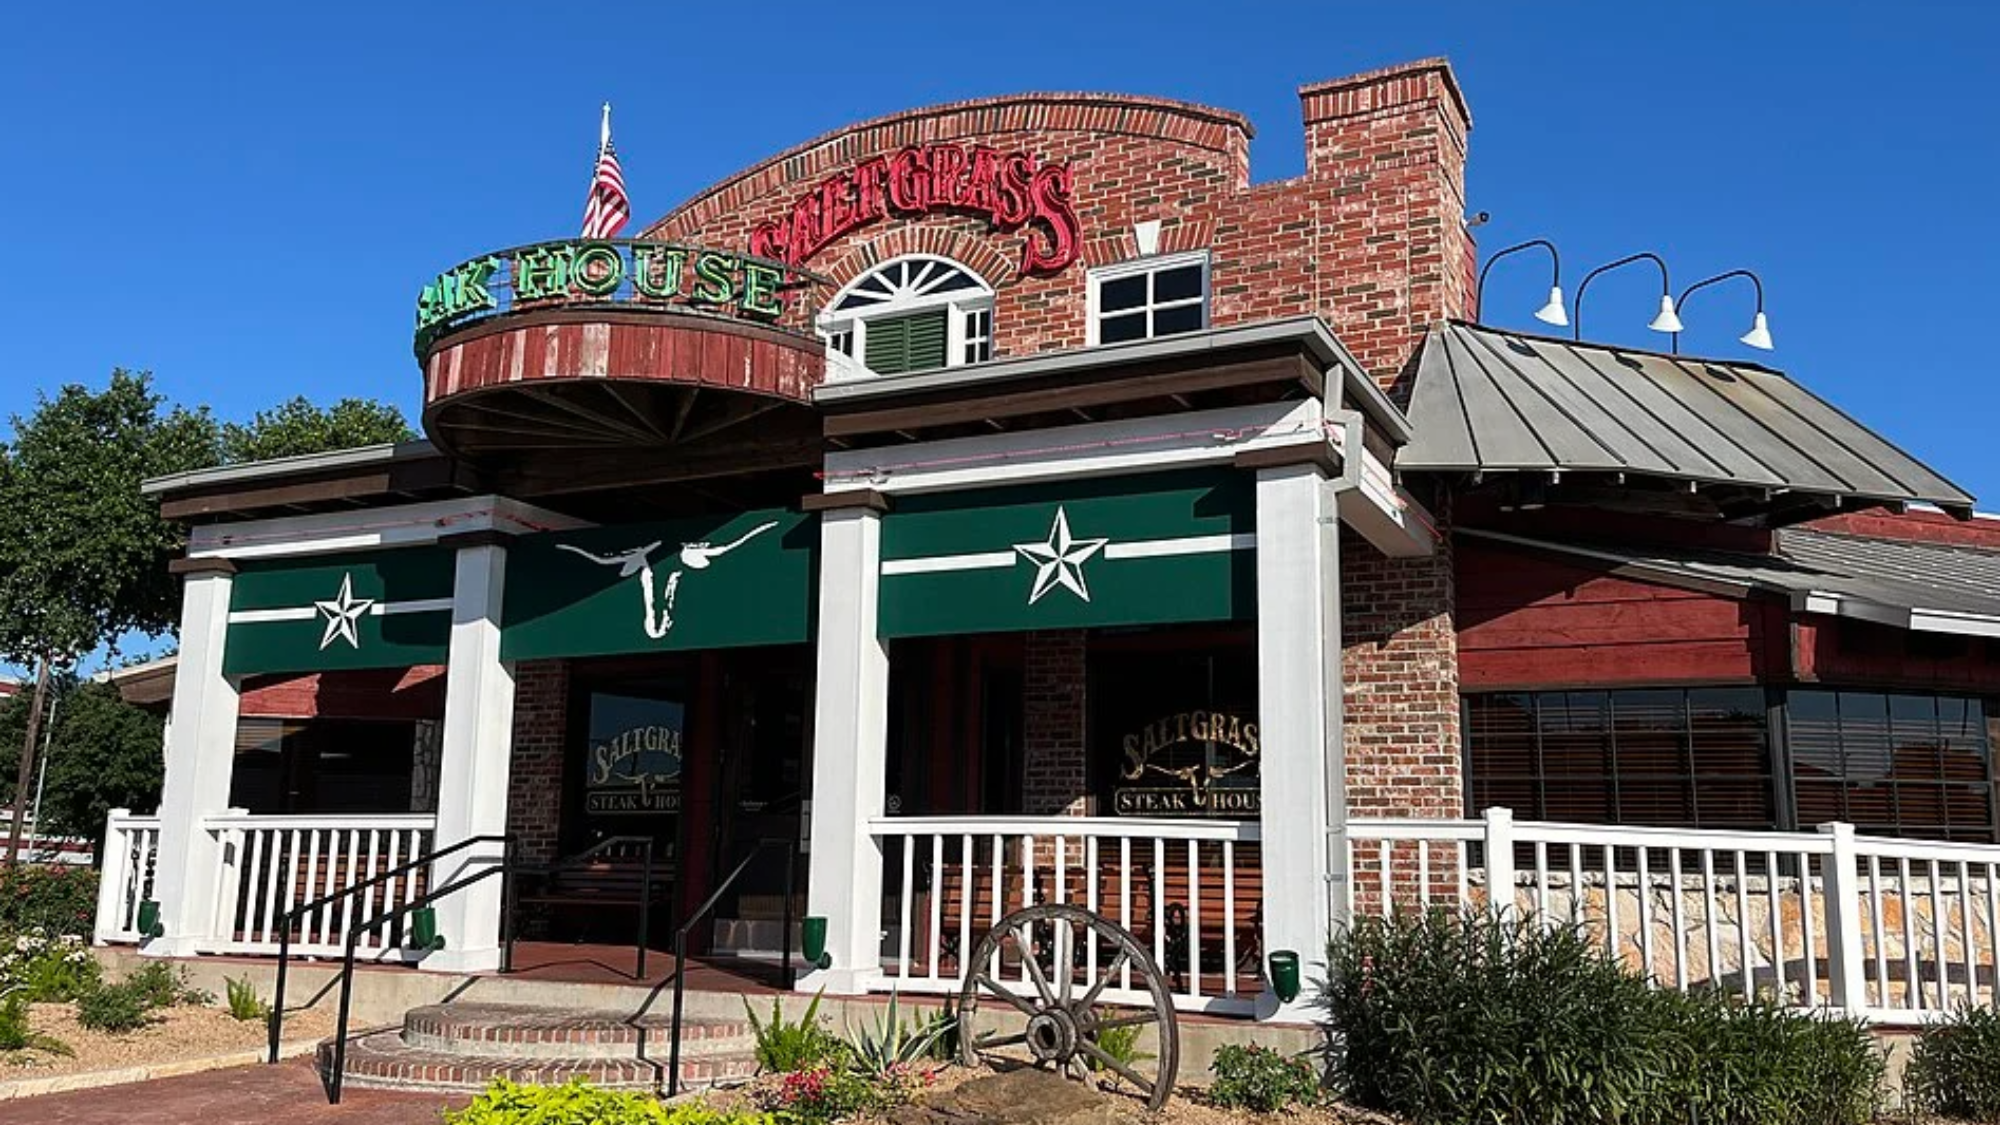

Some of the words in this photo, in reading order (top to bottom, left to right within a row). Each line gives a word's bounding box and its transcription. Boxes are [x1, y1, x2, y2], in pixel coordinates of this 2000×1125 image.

[750, 143, 1084, 281] SALTGRASS
[513, 243, 787, 318] HOUSE
[1121, 710, 1259, 780] SALTGRAS
[590, 796, 637, 809] STEAK
[1120, 793, 1185, 809] STEAK
